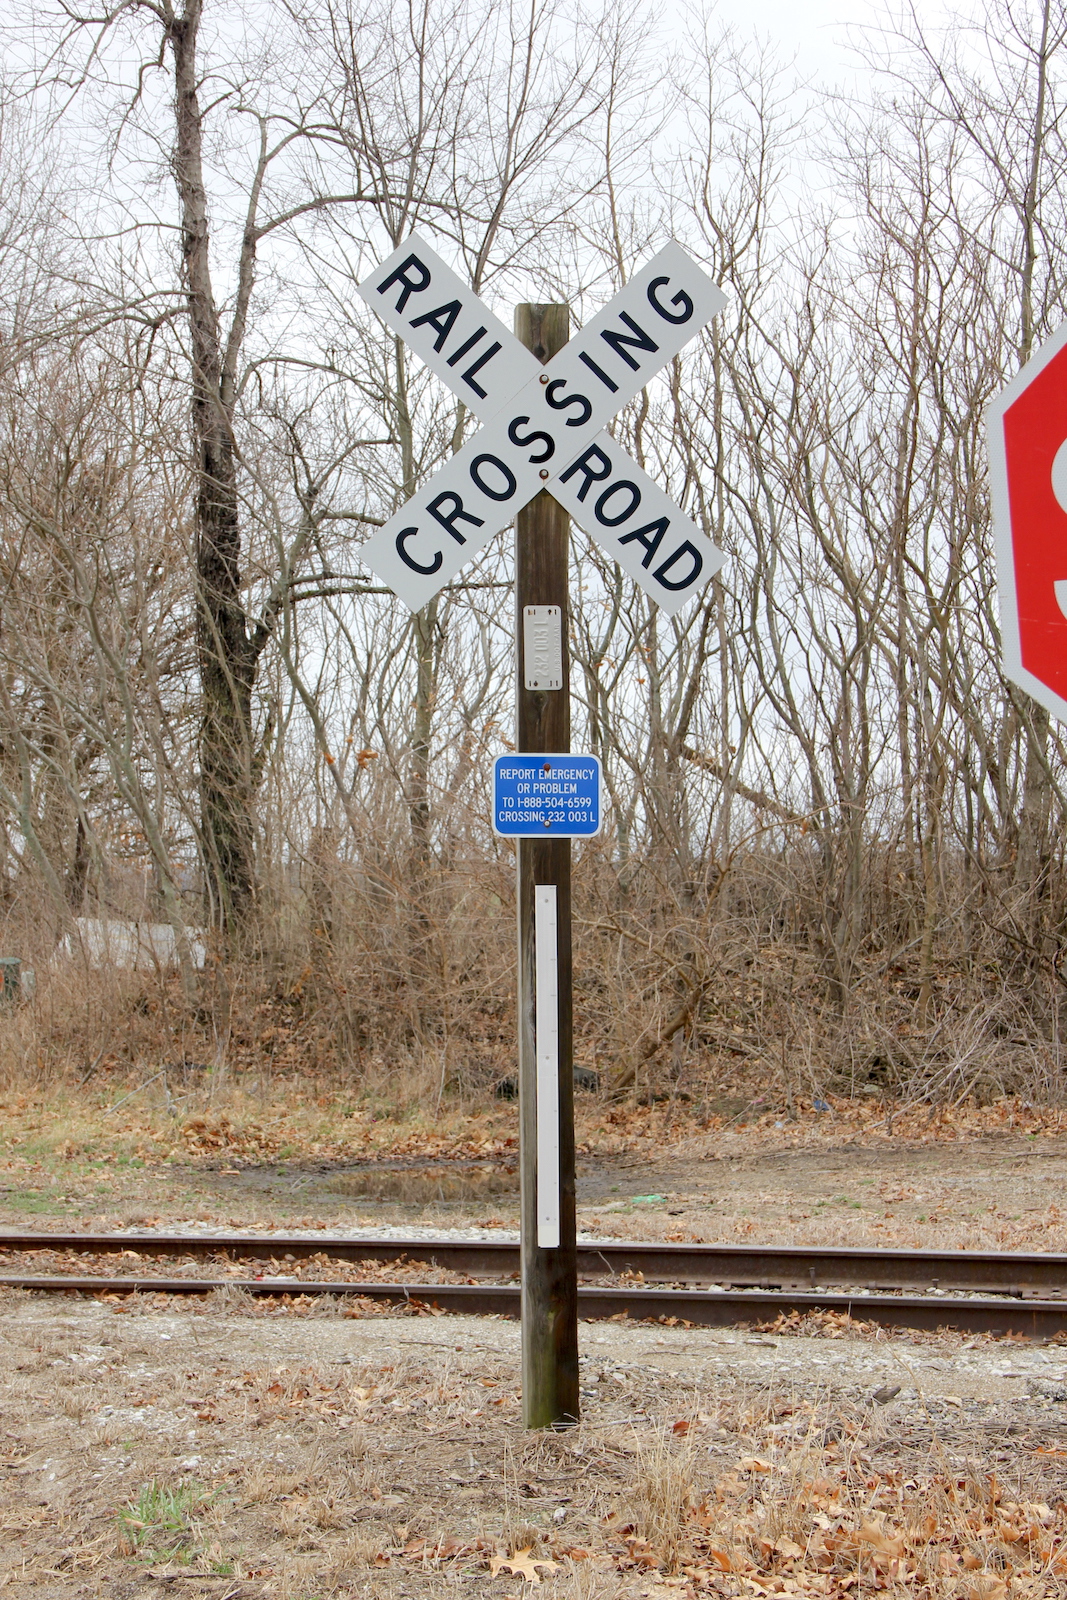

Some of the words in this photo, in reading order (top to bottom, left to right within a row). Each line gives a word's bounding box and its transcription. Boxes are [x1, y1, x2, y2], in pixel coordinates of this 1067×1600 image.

[376, 253, 503, 400] RAIL
[558, 443, 703, 591] ROAD
[395, 276, 694, 576] CROSSING
[499, 768, 536, 780] REPORT
[538, 768, 595, 780] EMERGENCY
[517, 782, 531, 794] OR
[533, 782, 578, 794] PROBLEM
[502, 797, 515, 808] TO
[517, 797, 592, 808] 1-888-504-6599
[498, 811, 545, 822] CROSSING
[547, 811, 566, 822] 232
[567, 811, 588, 822] 003
[589, 811, 597, 822] L
